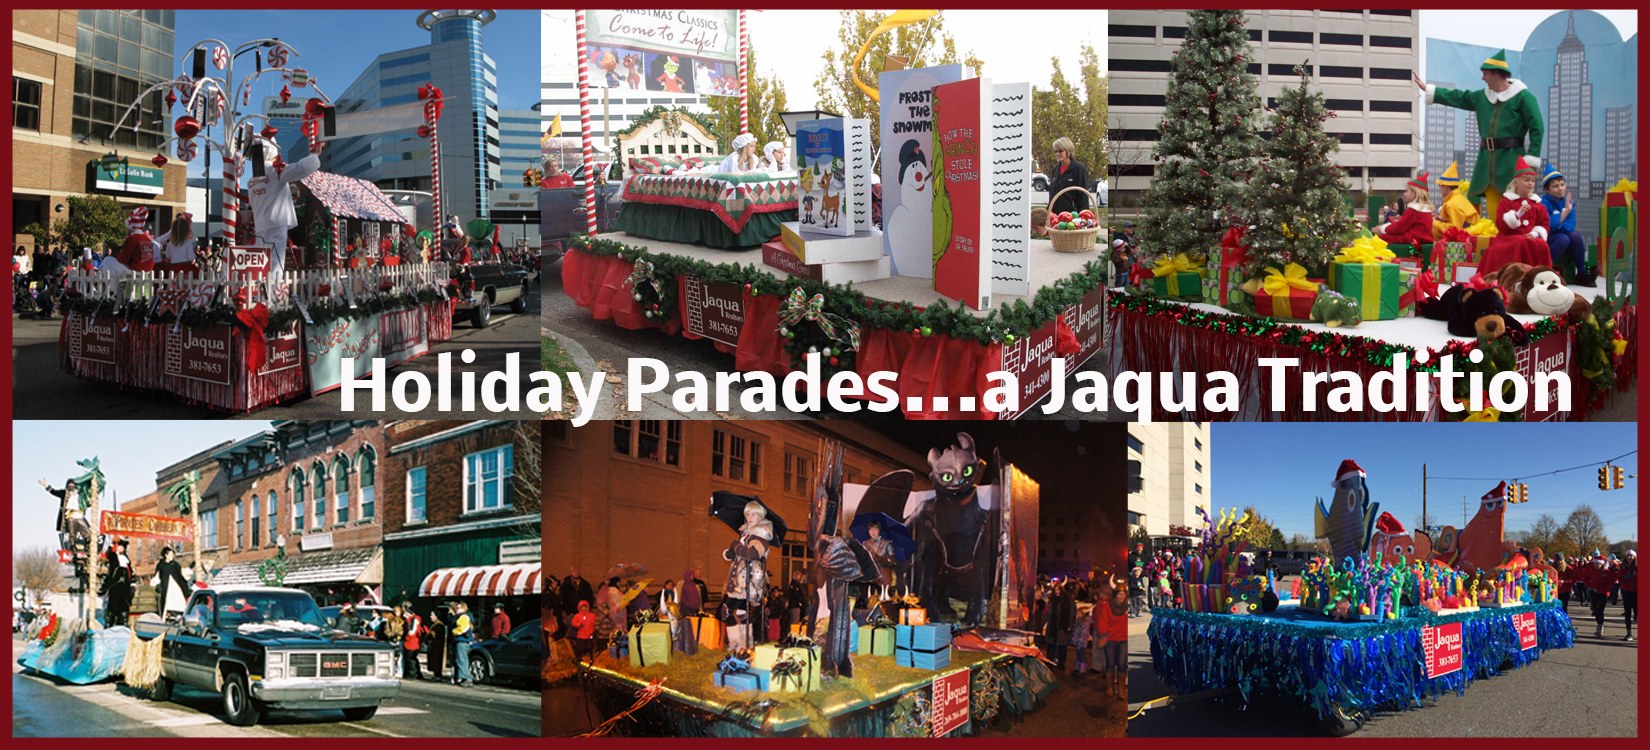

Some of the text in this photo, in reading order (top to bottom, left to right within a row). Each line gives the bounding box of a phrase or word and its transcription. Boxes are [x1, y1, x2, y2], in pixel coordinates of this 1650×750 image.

[614, 9, 673, 21] RISTMAS
[609, 14, 718, 55] Come to Life!
[899, 90, 932, 104] FROST
[959, 128, 973, 138] THE
[951, 159, 973, 170] STOLE
[237, 253, 264, 266] OPEN
[703, 285, 740, 317] Jaqua
[83, 317, 111, 340] Jaqua
[709, 320, 738, 336] 381-7653
[1076, 304, 1099, 333] Jaqua
[184, 327, 224, 356] Jaqua
[270, 347, 295, 363] Jaqua
[1021, 336, 1053, 372] Jaqua
[1530, 347, 1564, 384] Jaqua
[188, 360, 222, 374] 381-7653
[1435, 628, 1459, 651] Jaqua
[944, 682, 967, 705] Jaqua
